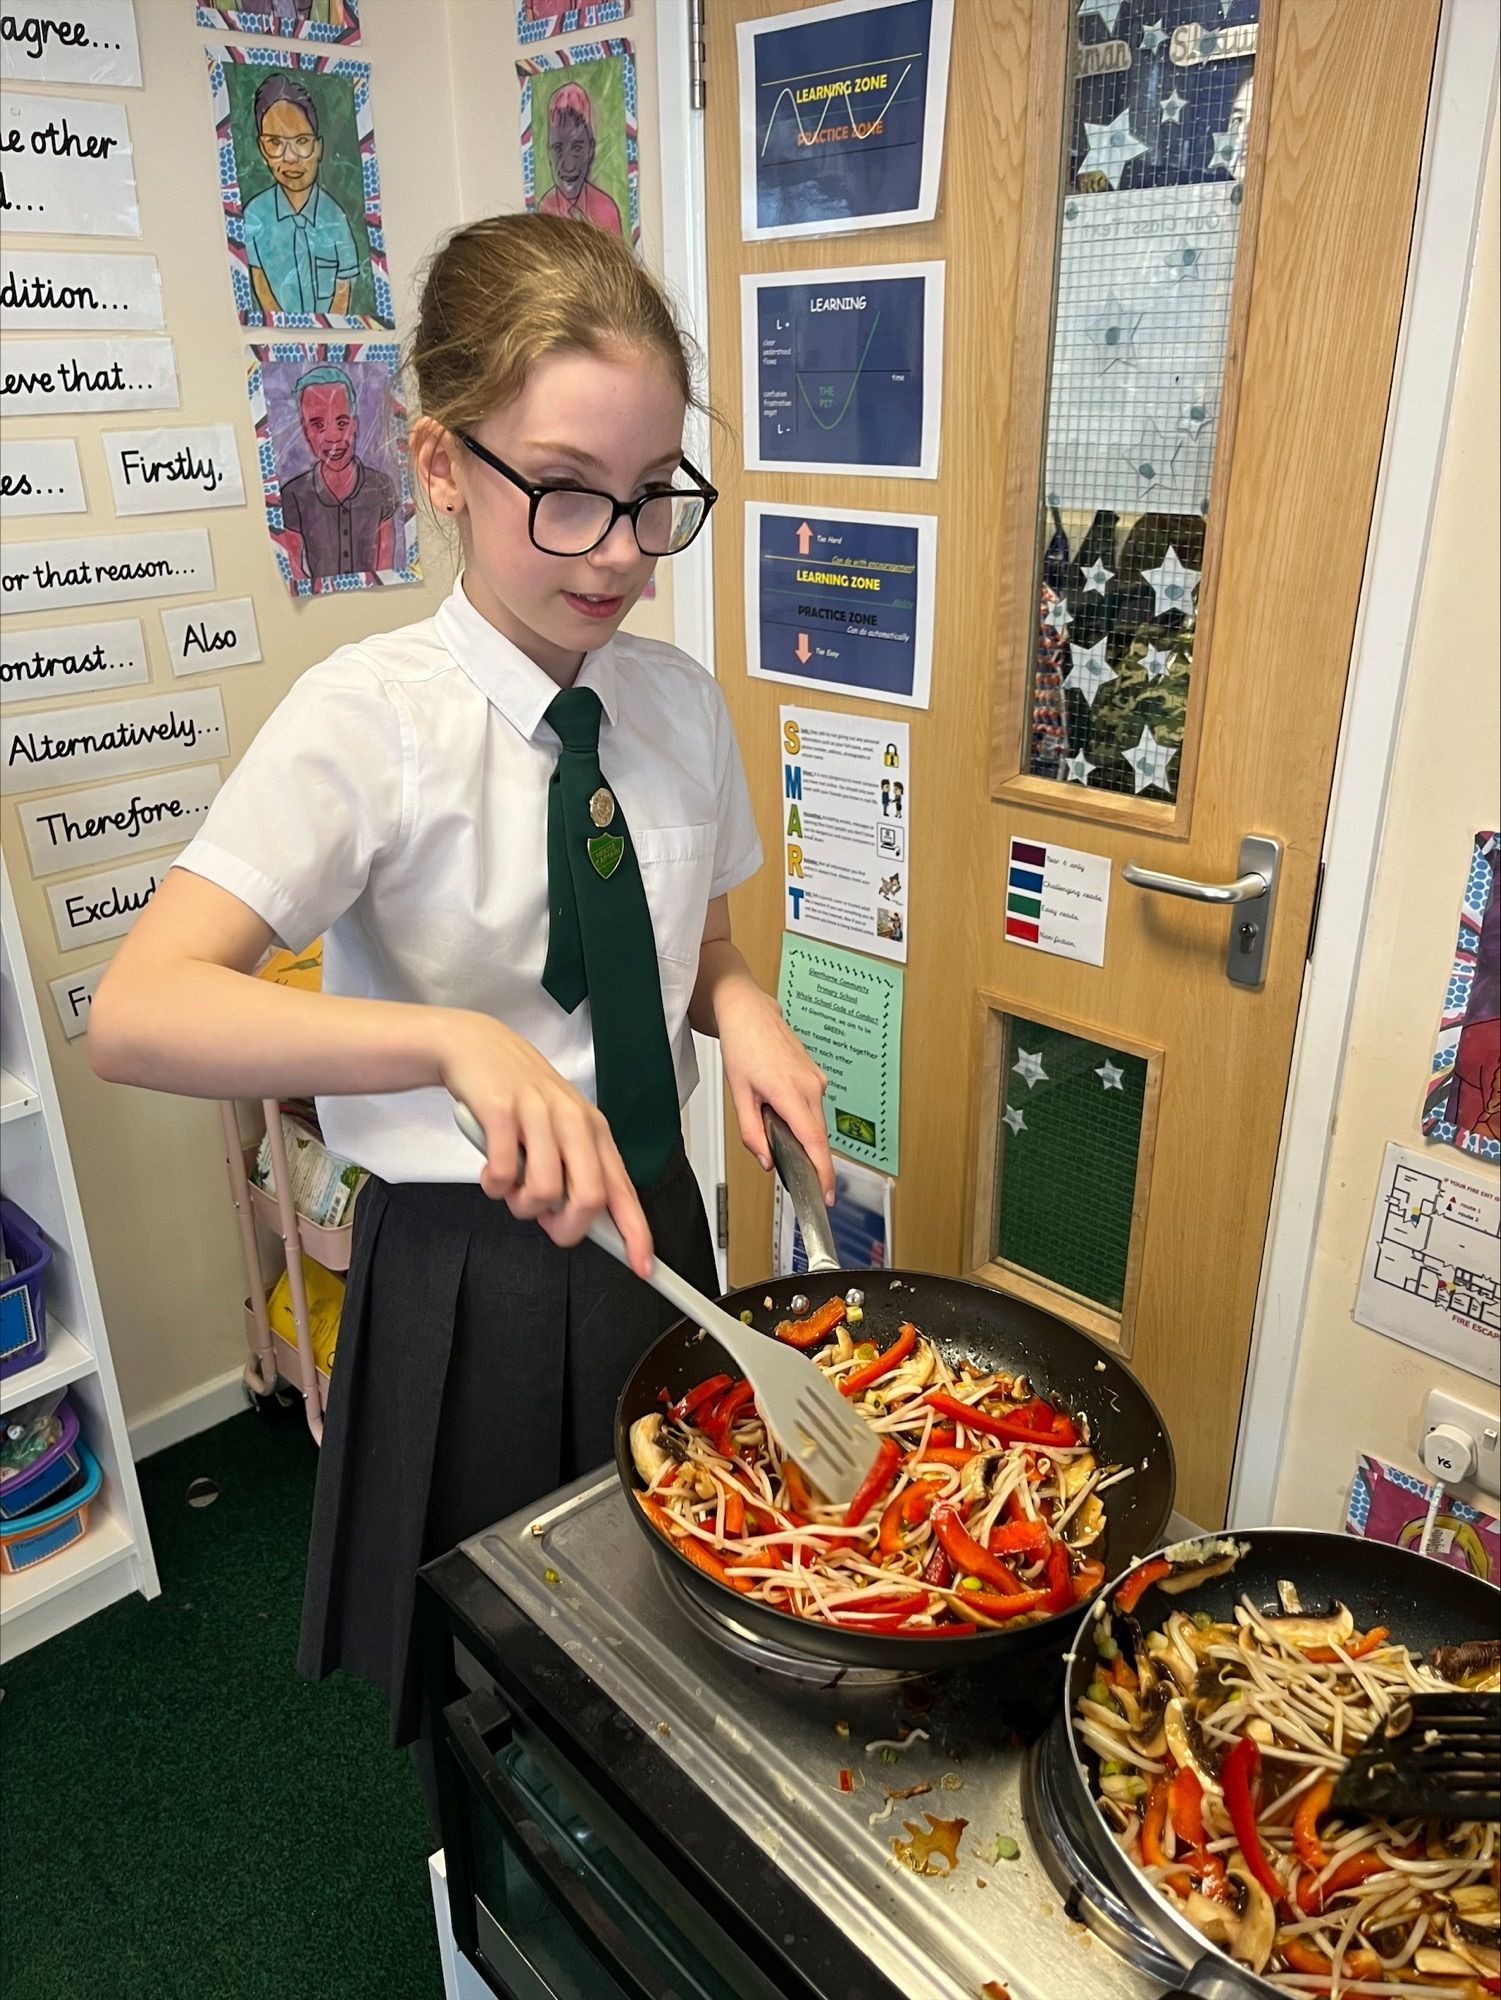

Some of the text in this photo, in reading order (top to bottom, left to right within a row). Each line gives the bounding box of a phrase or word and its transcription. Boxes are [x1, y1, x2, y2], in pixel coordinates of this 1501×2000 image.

[1, 16, 121, 58] agree...
[795, 74, 888, 104] LEARNING ZONE
[31, 118, 118, 159] other
[797, 120, 884, 147] PRACTICE ZONE
[809, 296, 867, 313] LEARNING
[58, 359, 153, 393] that...
[121, 446, 224, 490] Firstly,
[827, 535, 843, 545] Hard
[2, 558, 195, 592] or that reason...
[796, 570, 881, 591] LEARNING ZONE
[798, 604, 878, 626] PRACTICE ZONE
[182, 622, 238, 657] Also
[846, 626, 859, 635] Can
[868, 627, 910, 643] automatically
[8, 711, 220, 767] Alternatively...
[37, 796, 209, 847] Therefore...
[816, 983, 858, 1005] Primary School
[839, 978, 870, 996] Community
[814, 996, 833, 1010] School
[832, 1002, 847, 1014] Code
[855, 1010, 879, 1026] Conduct
[857, 1024, 864, 1032] to
[864, 1026, 871, 1034] be
[793, 1025, 878, 1061] Great teams work together
[819, 1049, 833, 1060] each
[835, 1055, 853, 1066] other
[1450, 1180, 1466, 1190] YOUR
[1466, 1185, 1480, 1195] FIRE
[1480, 1191, 1494, 1200] EXIT
[1458, 1211, 1474, 1220] route
[1460, 1202, 1476, 1212] route
[1452, 1314, 1471, 1328] FIRE
[1437, 1455, 1452, 1470] Y6
